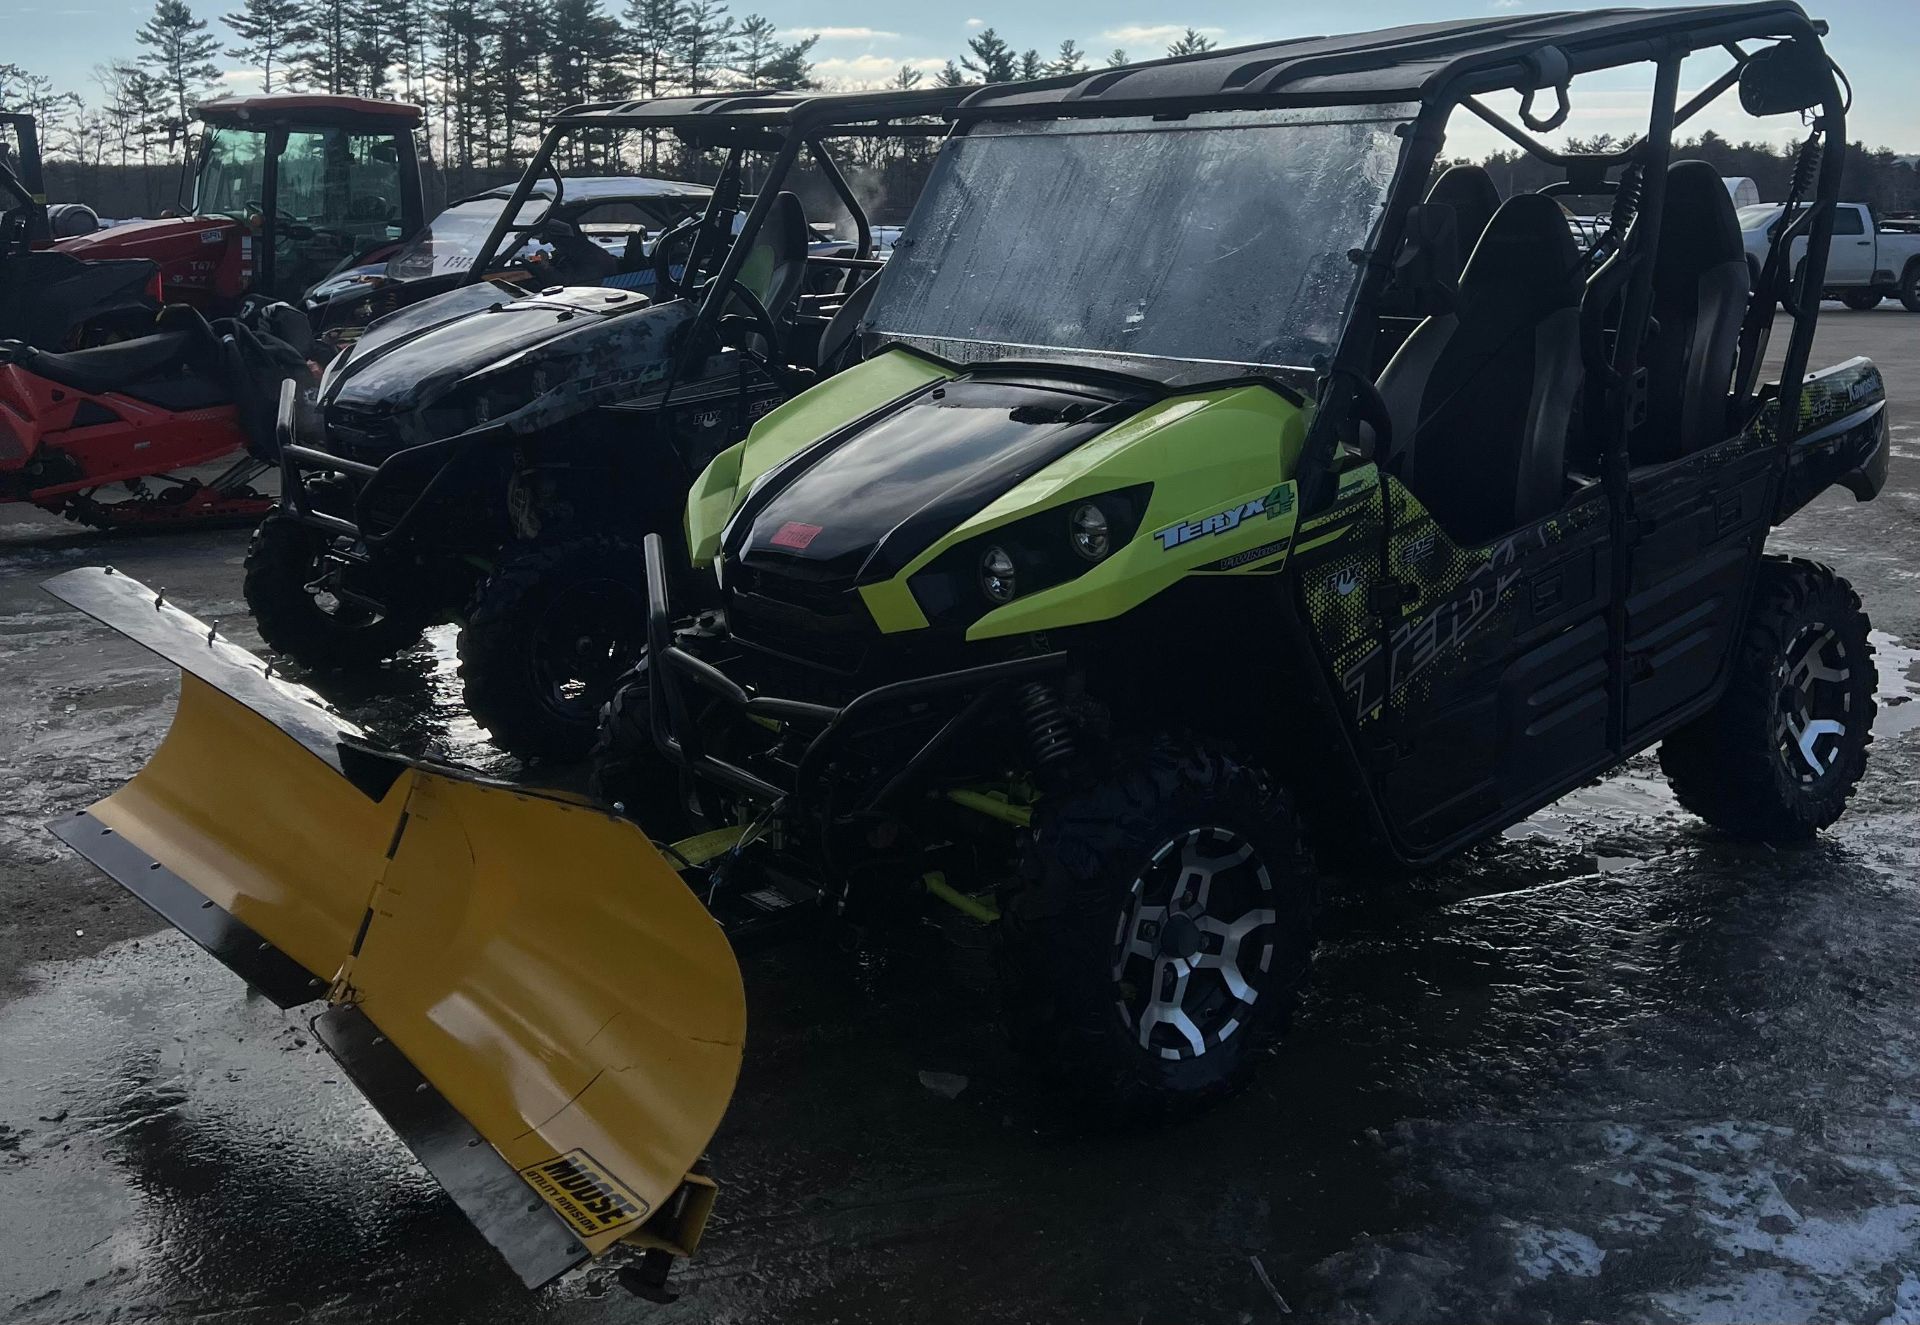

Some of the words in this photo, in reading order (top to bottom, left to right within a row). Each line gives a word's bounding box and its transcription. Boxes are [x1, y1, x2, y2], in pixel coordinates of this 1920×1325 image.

[1324, 561, 1364, 595] FOX
[526, 1171, 559, 1198] UTILITY
[555, 1192, 599, 1232] DIVISION
[541, 1156, 639, 1225] MOOSE
